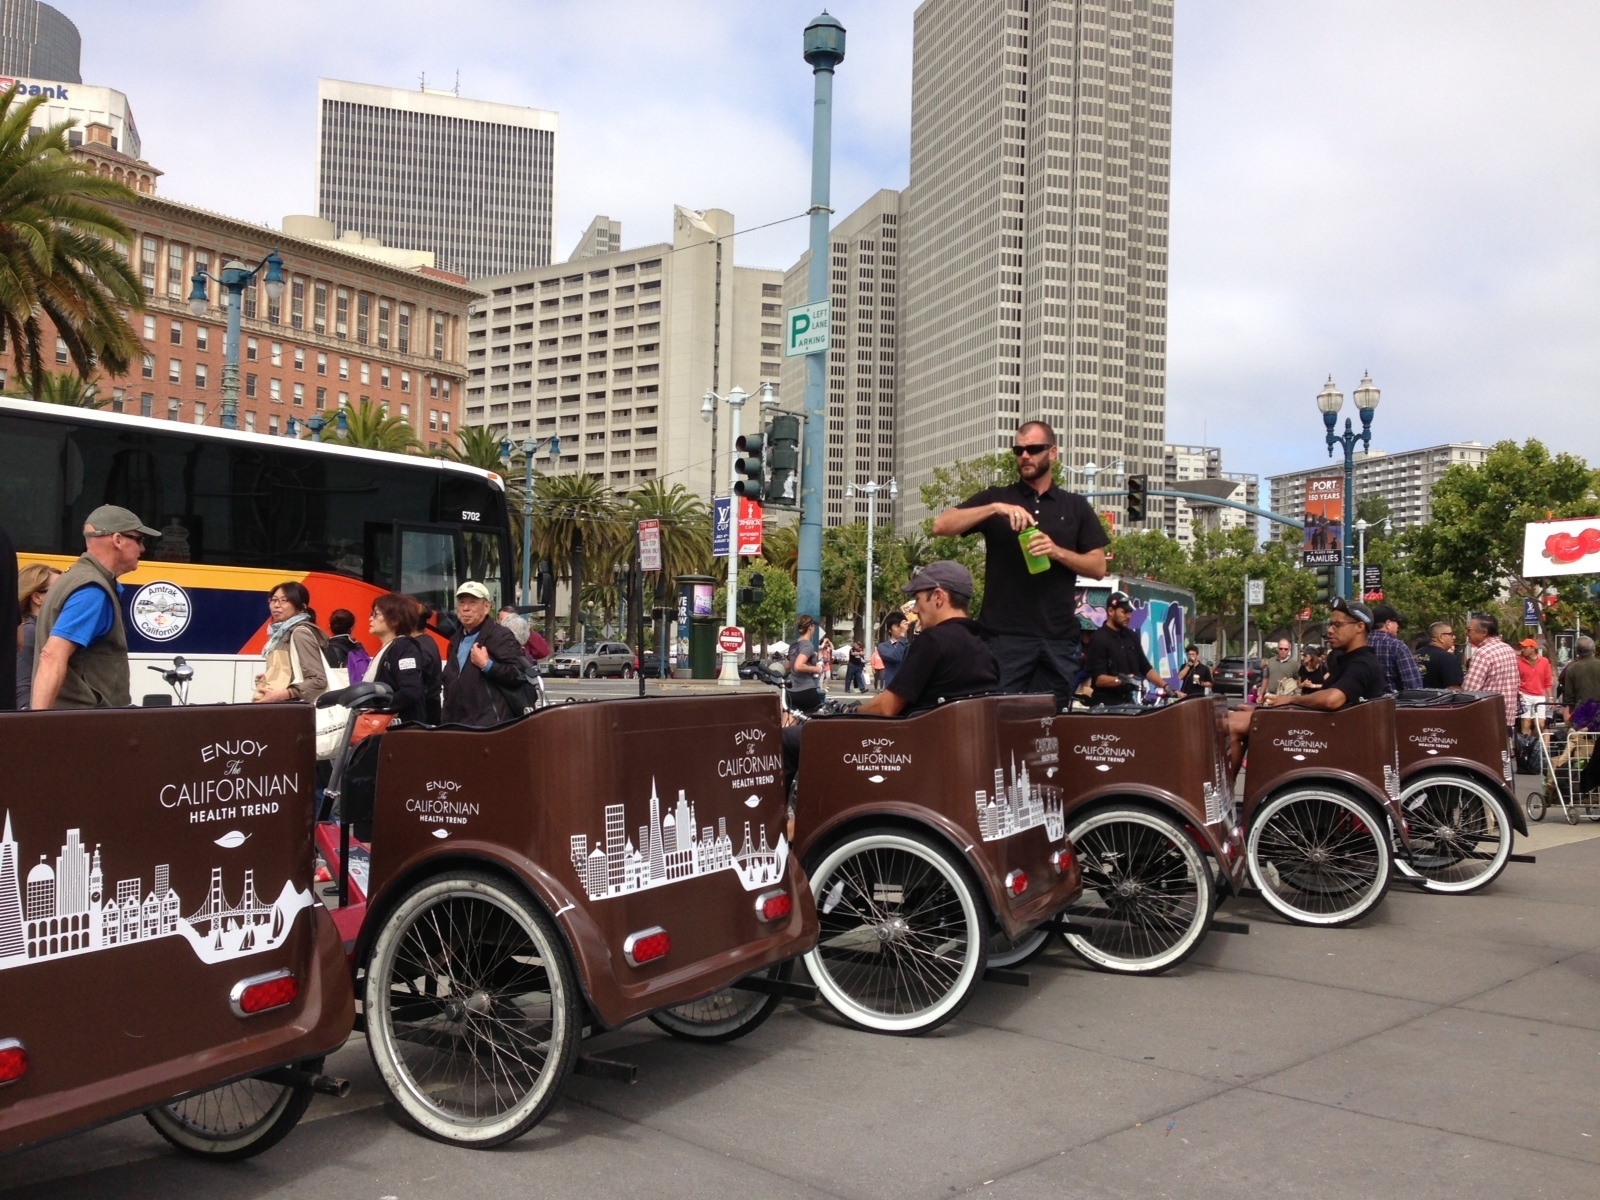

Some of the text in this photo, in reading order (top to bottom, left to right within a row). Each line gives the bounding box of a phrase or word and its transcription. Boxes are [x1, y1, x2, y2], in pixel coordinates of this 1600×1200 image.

[16, 80, 68, 100] bank
[812, 309, 827, 318] LEFT
[812, 320, 828, 330] LANE
[1313, 480, 1337, 490] PORT
[462, 510, 480, 521] 5702
[1306, 554, 1339, 562] FAMILIES
[148, 586, 177, 597] Amtrak
[141, 622, 180, 636] California
[734, 728, 766, 746] ENJOY
[1090, 734, 1121, 742] ENJOY
[1408, 735, 1458, 744] CALIFORNIAN
[862, 738, 895, 748] ENJOY
[1272, 738, 1328, 748] CALIFORNIAN
[201, 740, 268, 762] ENJOY
[1074, 744, 1135, 757] CALIFORNIAN
[843, 753, 912, 764] CALIFORNIAN
[224, 760, 244, 776] The
[718, 754, 782, 778] CALIFORNIAN
[426, 780, 462, 792] ENJOY
[732, 774, 775, 789] HEALTH TREND
[160, 772, 298, 808] CALIFORNIAN
[406, 798, 480, 816] CALIFORNIAN
[190, 802, 279, 824] HEALTH TREND
[446, 816, 468, 824] TREND
